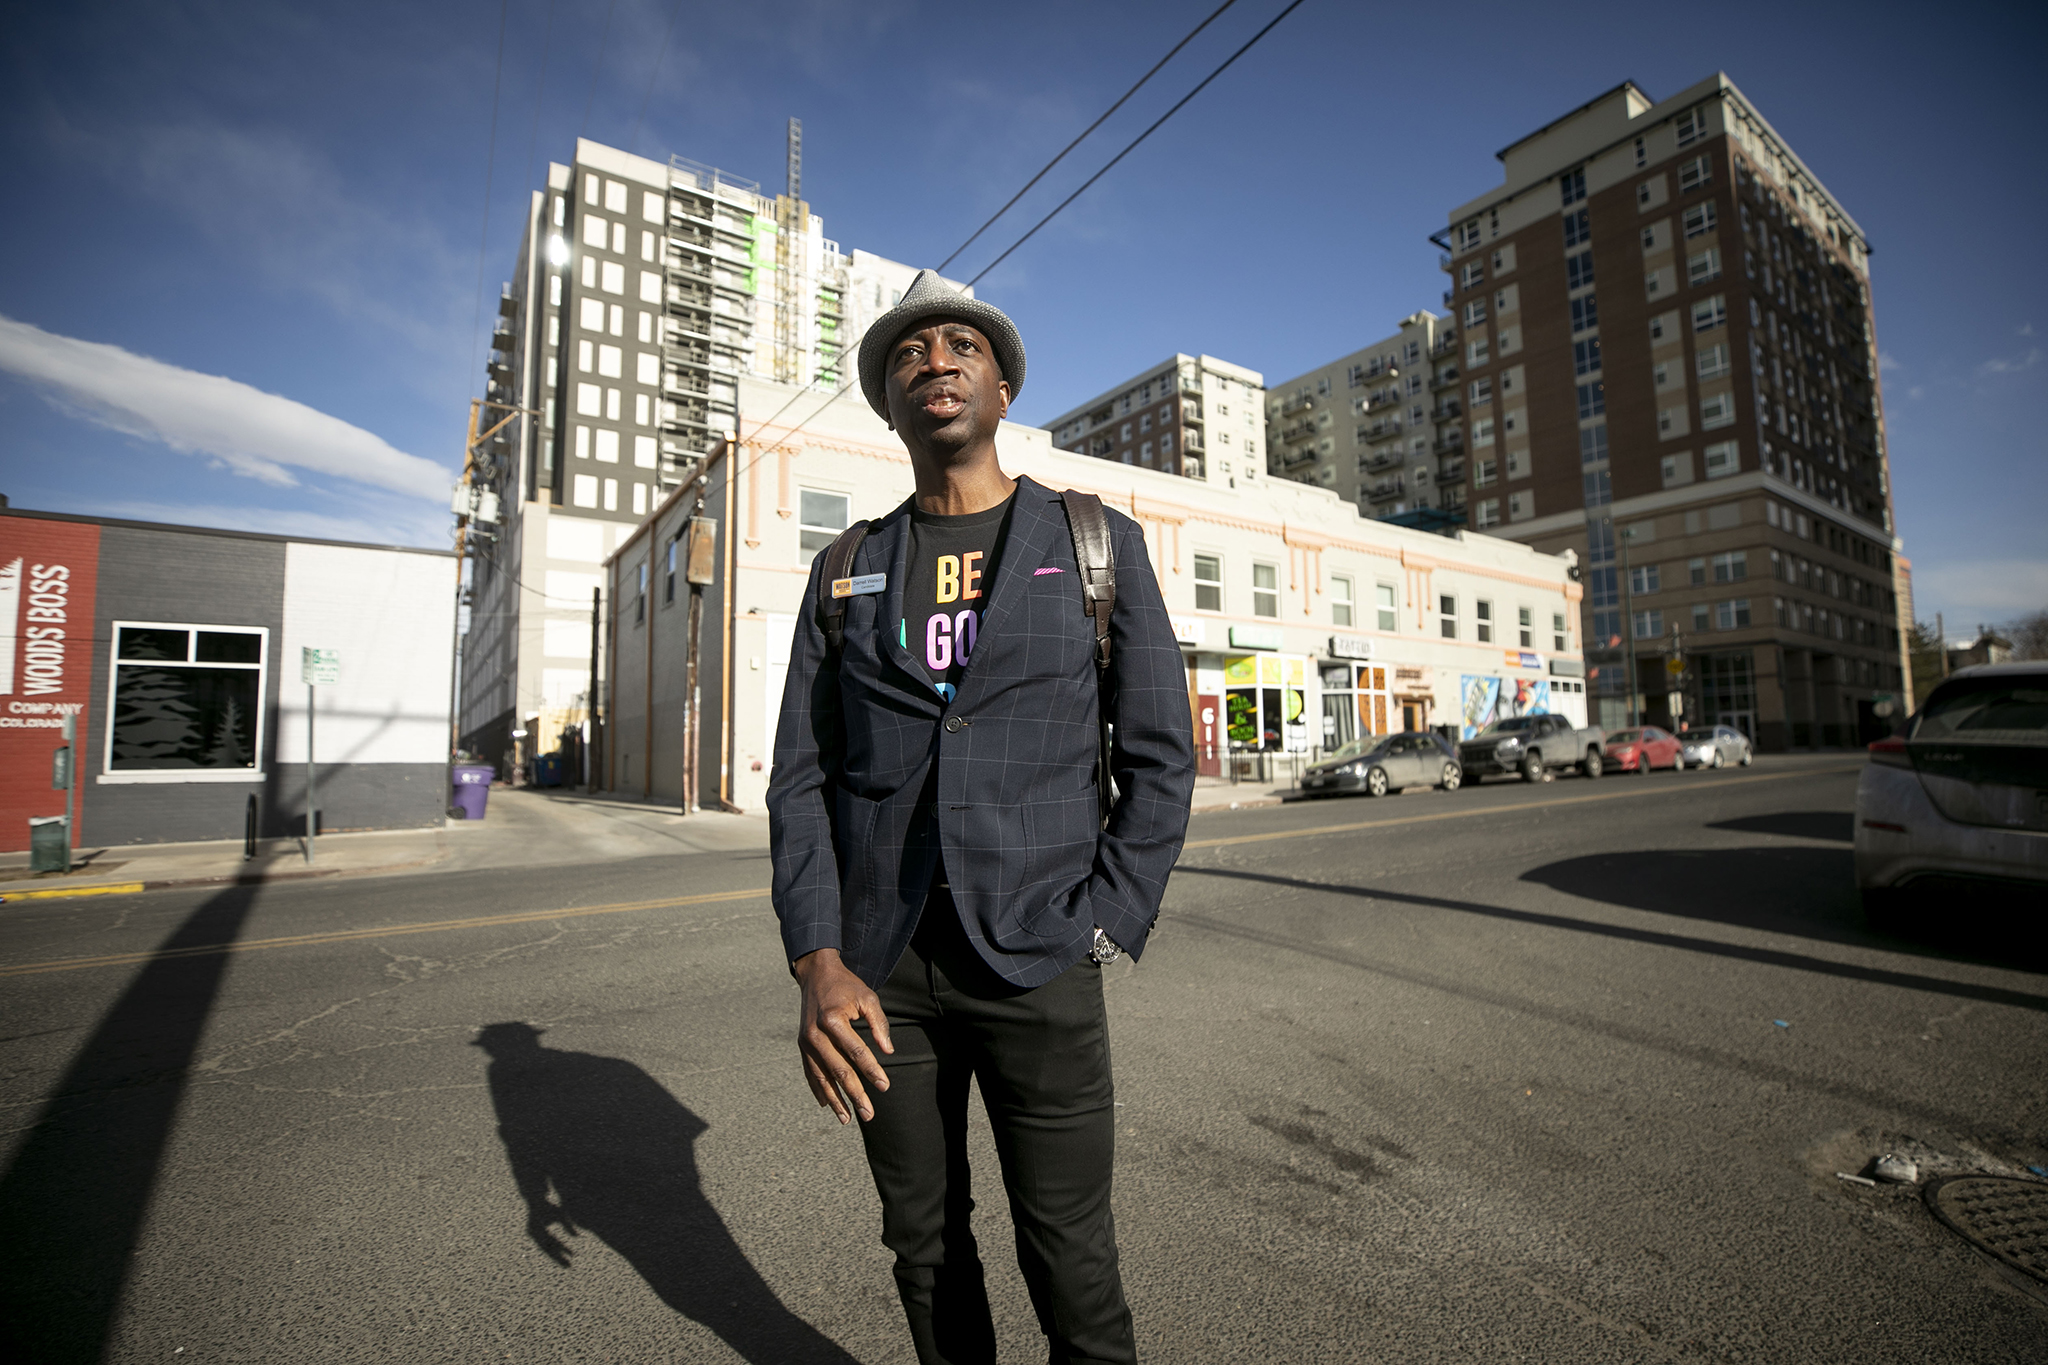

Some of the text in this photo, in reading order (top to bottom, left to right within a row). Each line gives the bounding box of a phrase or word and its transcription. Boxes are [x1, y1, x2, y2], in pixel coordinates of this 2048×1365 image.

[936, 550, 984, 604] BE
[23, 563, 70, 696] WOODS BOSS
[926, 609, 987, 671] GO
[8, 701, 84, 715] COMPANY
